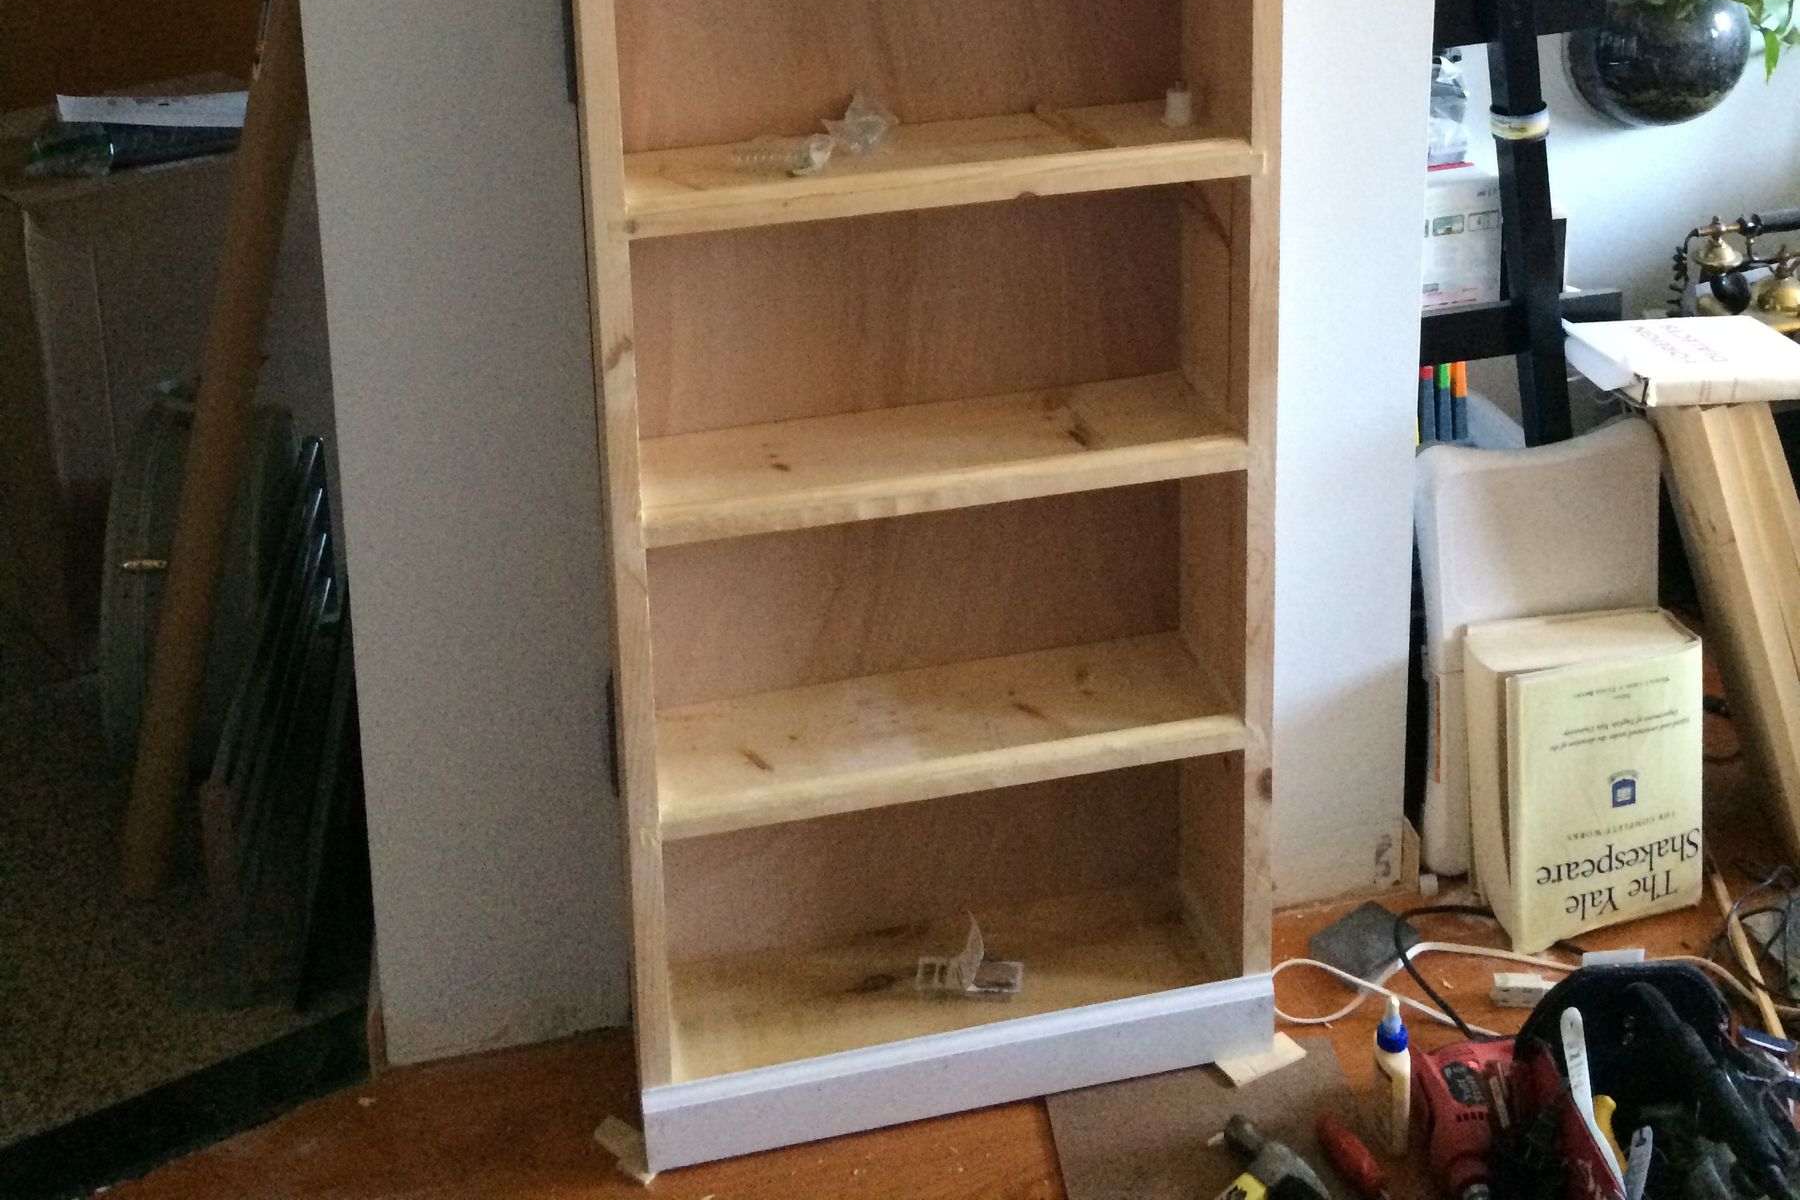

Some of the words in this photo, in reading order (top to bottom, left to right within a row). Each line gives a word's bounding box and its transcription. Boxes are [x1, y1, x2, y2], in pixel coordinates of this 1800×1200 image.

[1536, 828, 1700, 885] Shakespeare
[1627, 869, 1678, 902] The
[1565, 886, 1620, 921] Yale
